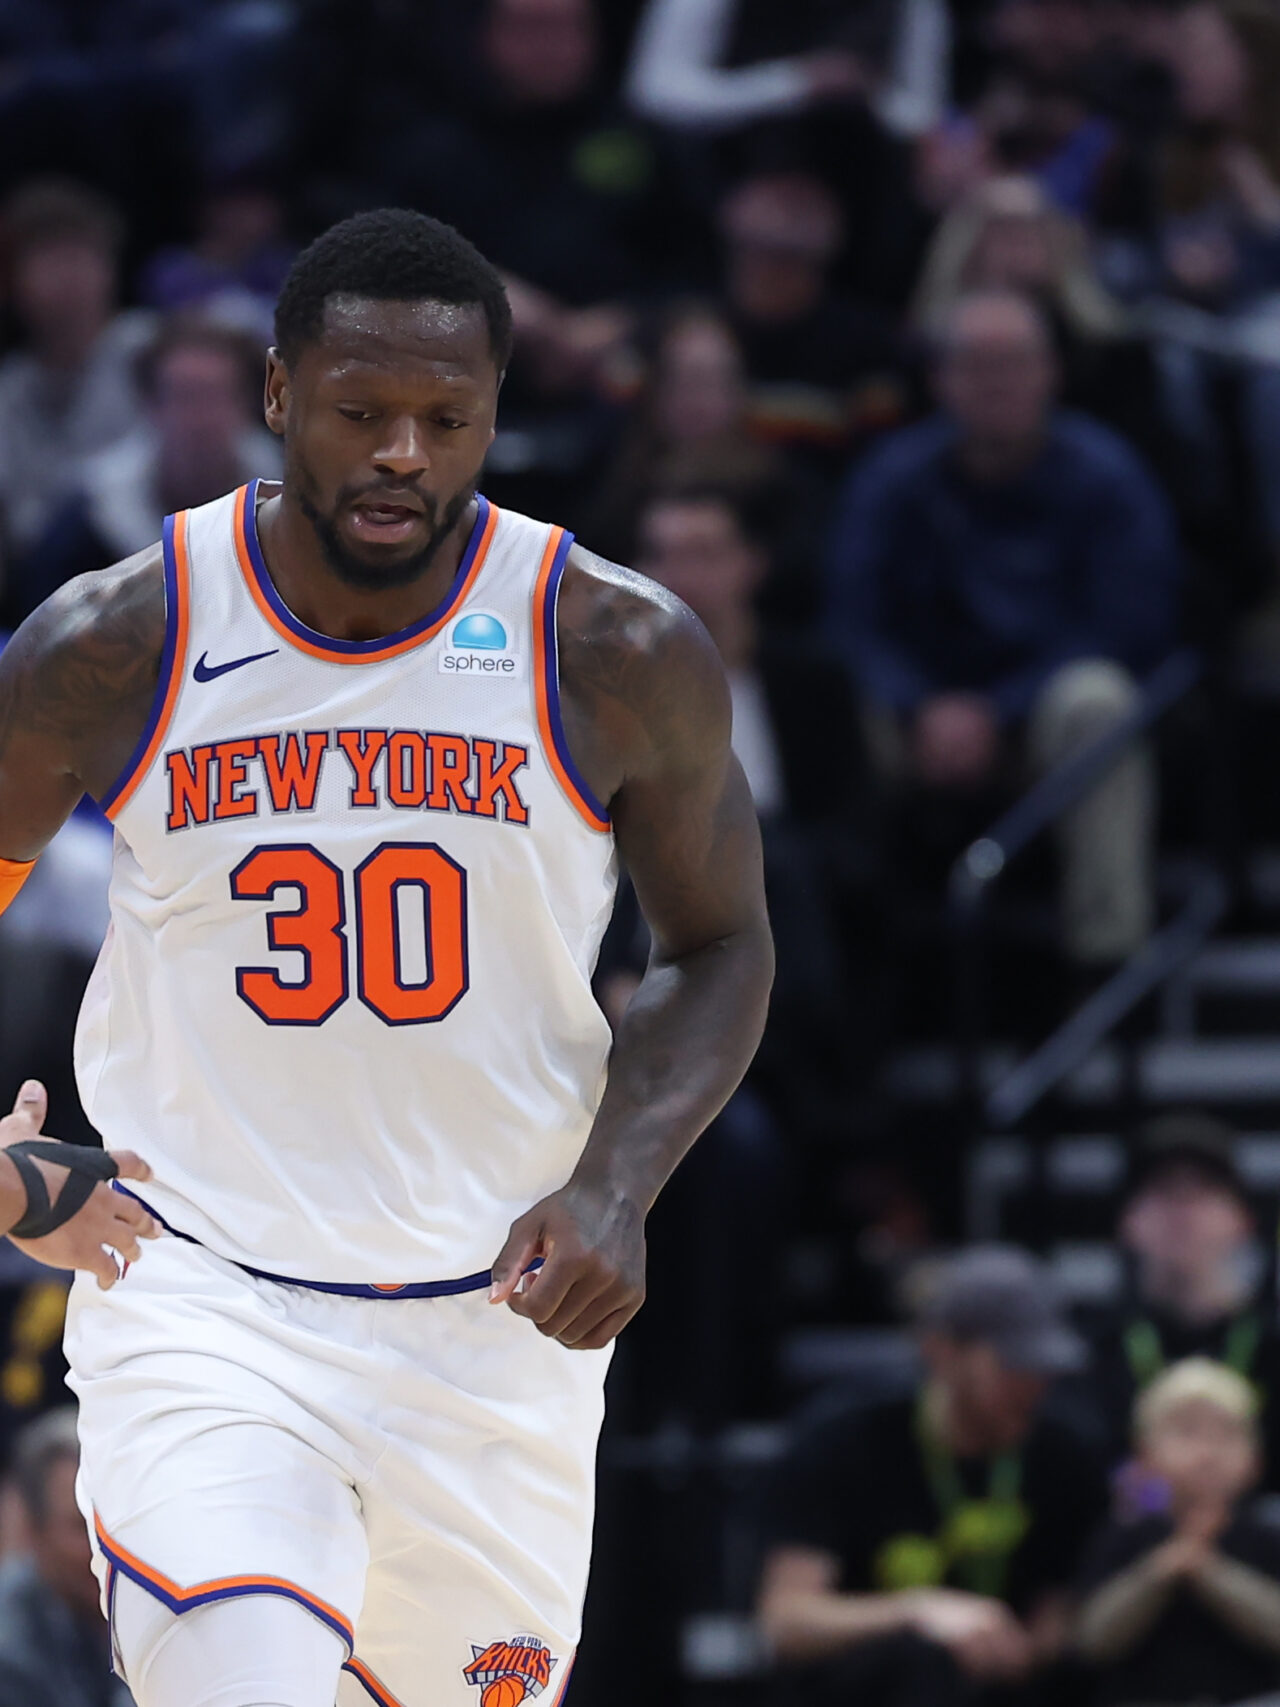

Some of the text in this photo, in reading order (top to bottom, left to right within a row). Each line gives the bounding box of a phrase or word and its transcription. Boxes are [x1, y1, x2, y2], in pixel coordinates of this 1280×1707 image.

[443, 654, 515, 672] sphere
[165, 727, 531, 834] NEW YORK
[229, 841, 470, 1027] 30
[463, 1641, 551, 1688] KNICKS
